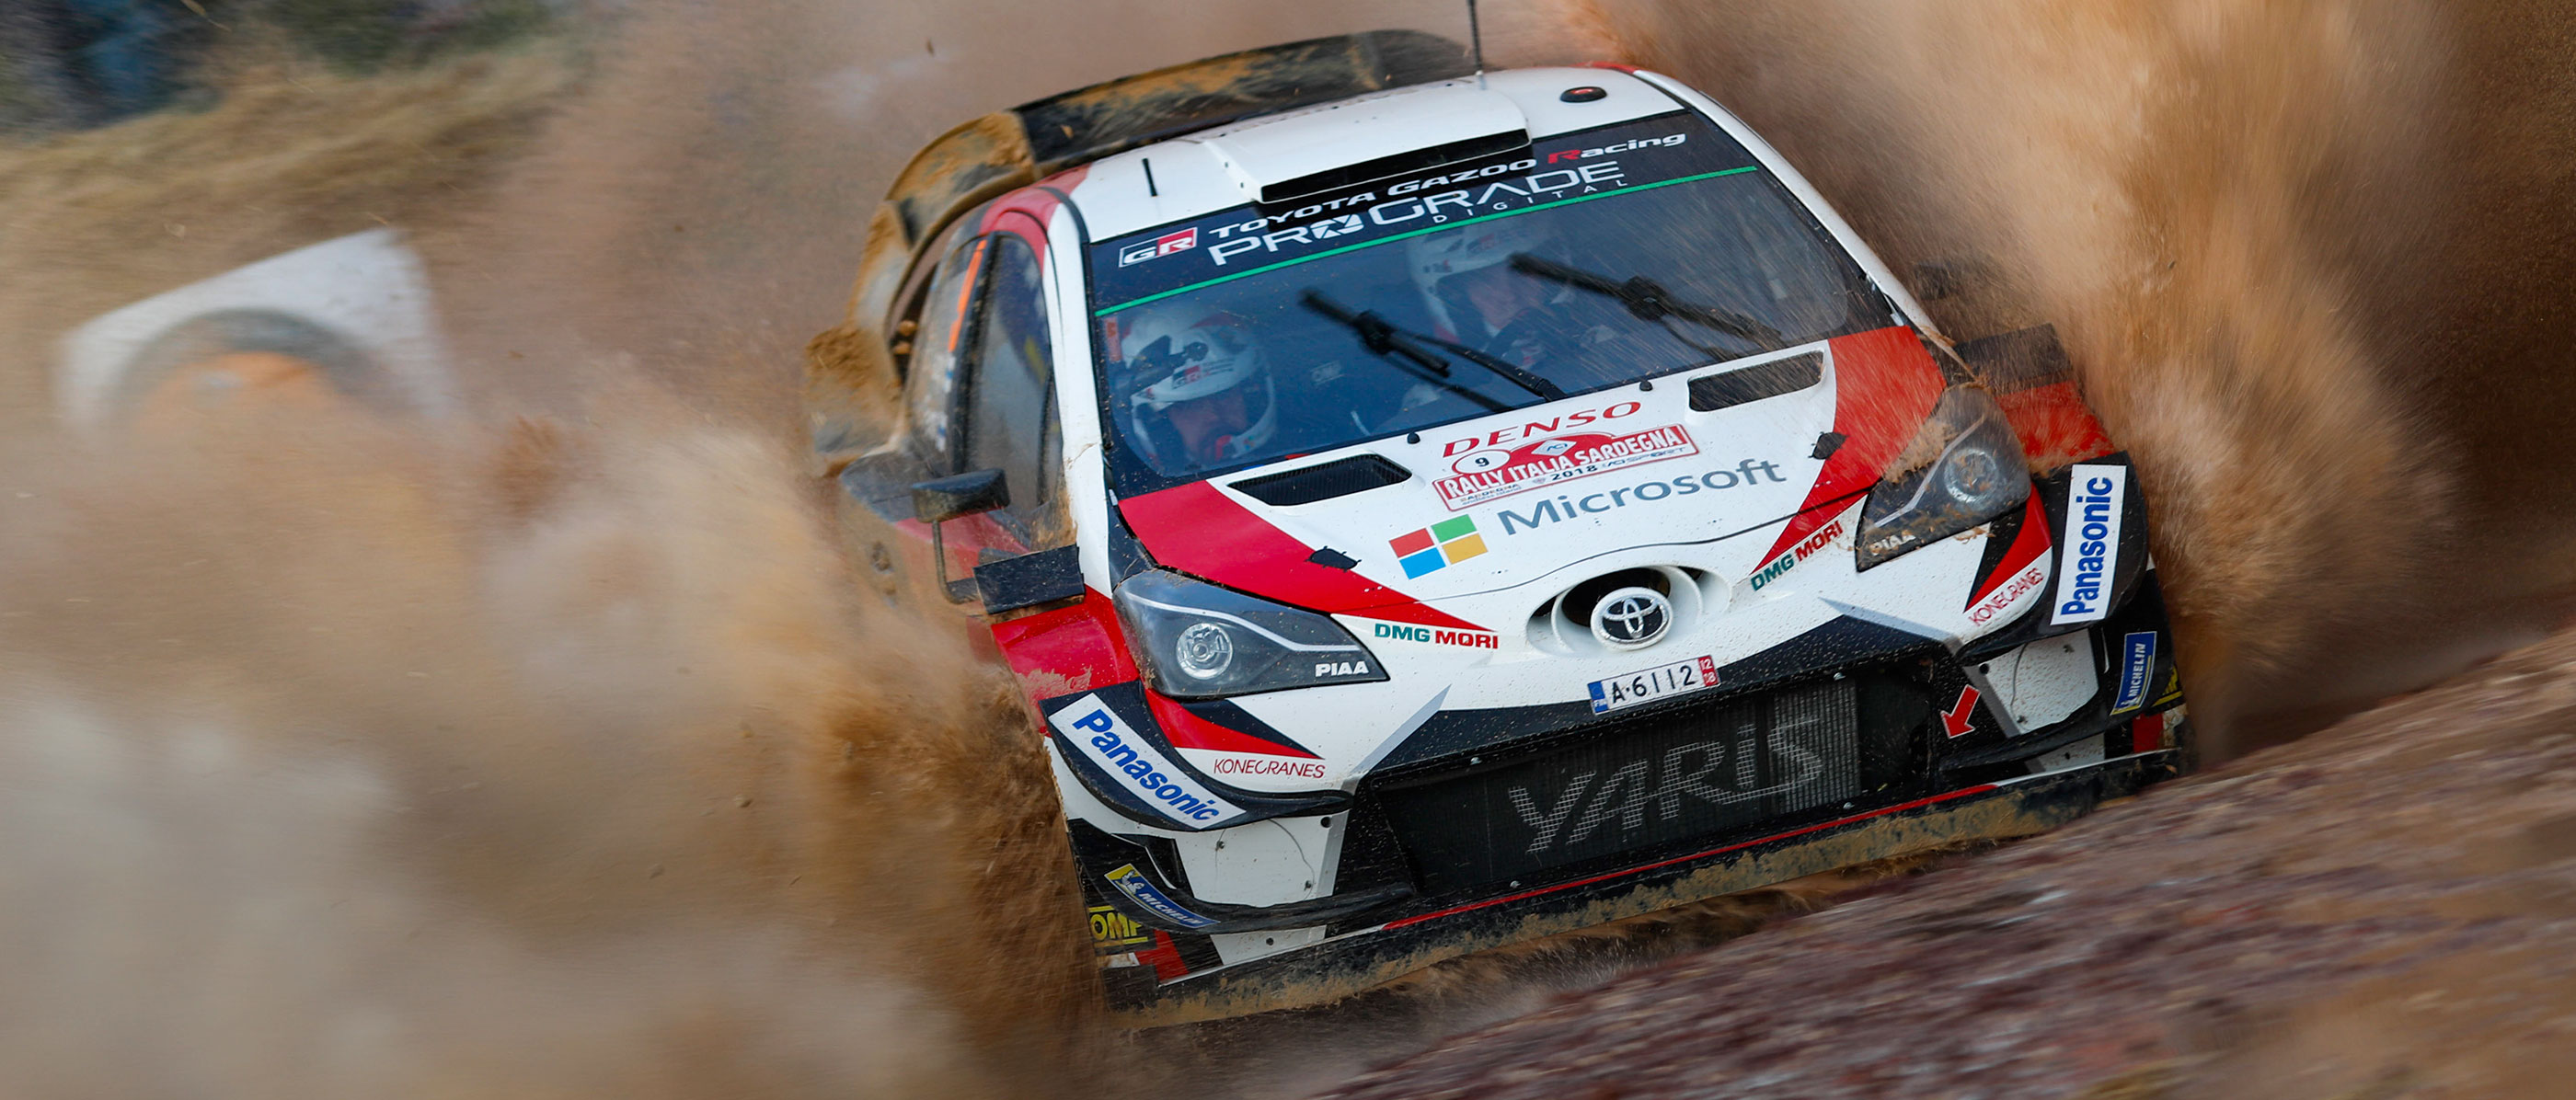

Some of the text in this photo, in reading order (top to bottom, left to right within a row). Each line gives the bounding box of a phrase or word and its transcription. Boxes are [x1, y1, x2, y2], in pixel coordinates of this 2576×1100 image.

[1208, 132, 1686, 239] TOYOTA GAZOO Racing
[1432, 179, 1627, 223] DIGITAL
[1122, 235, 1194, 265] GR
[1443, 401, 1641, 458] DENSO
[1443, 427, 1684, 498] RALLY ITALIA SARDEGNA
[1475, 457, 1490, 467] 9
[1551, 464, 1598, 481] 2018
[1497, 457, 1787, 536] Microsoft
[1751, 521, 1844, 592] DMG MORI
[2060, 476, 2113, 618] Panasonic
[1968, 567, 2045, 627] KONECRANES
[1374, 623, 1499, 649] DMG MORI
[1315, 660, 1370, 678] PIAA
[1699, 658, 1712, 670] 12
[2127, 643, 2146, 698] MICHELIN
[1072, 708, 1220, 821] Panasonic
[1213, 758, 1326, 779] KONECRANES
[1508, 714, 1823, 855] YARIS
[1138, 892, 1204, 925] MICHELIN
